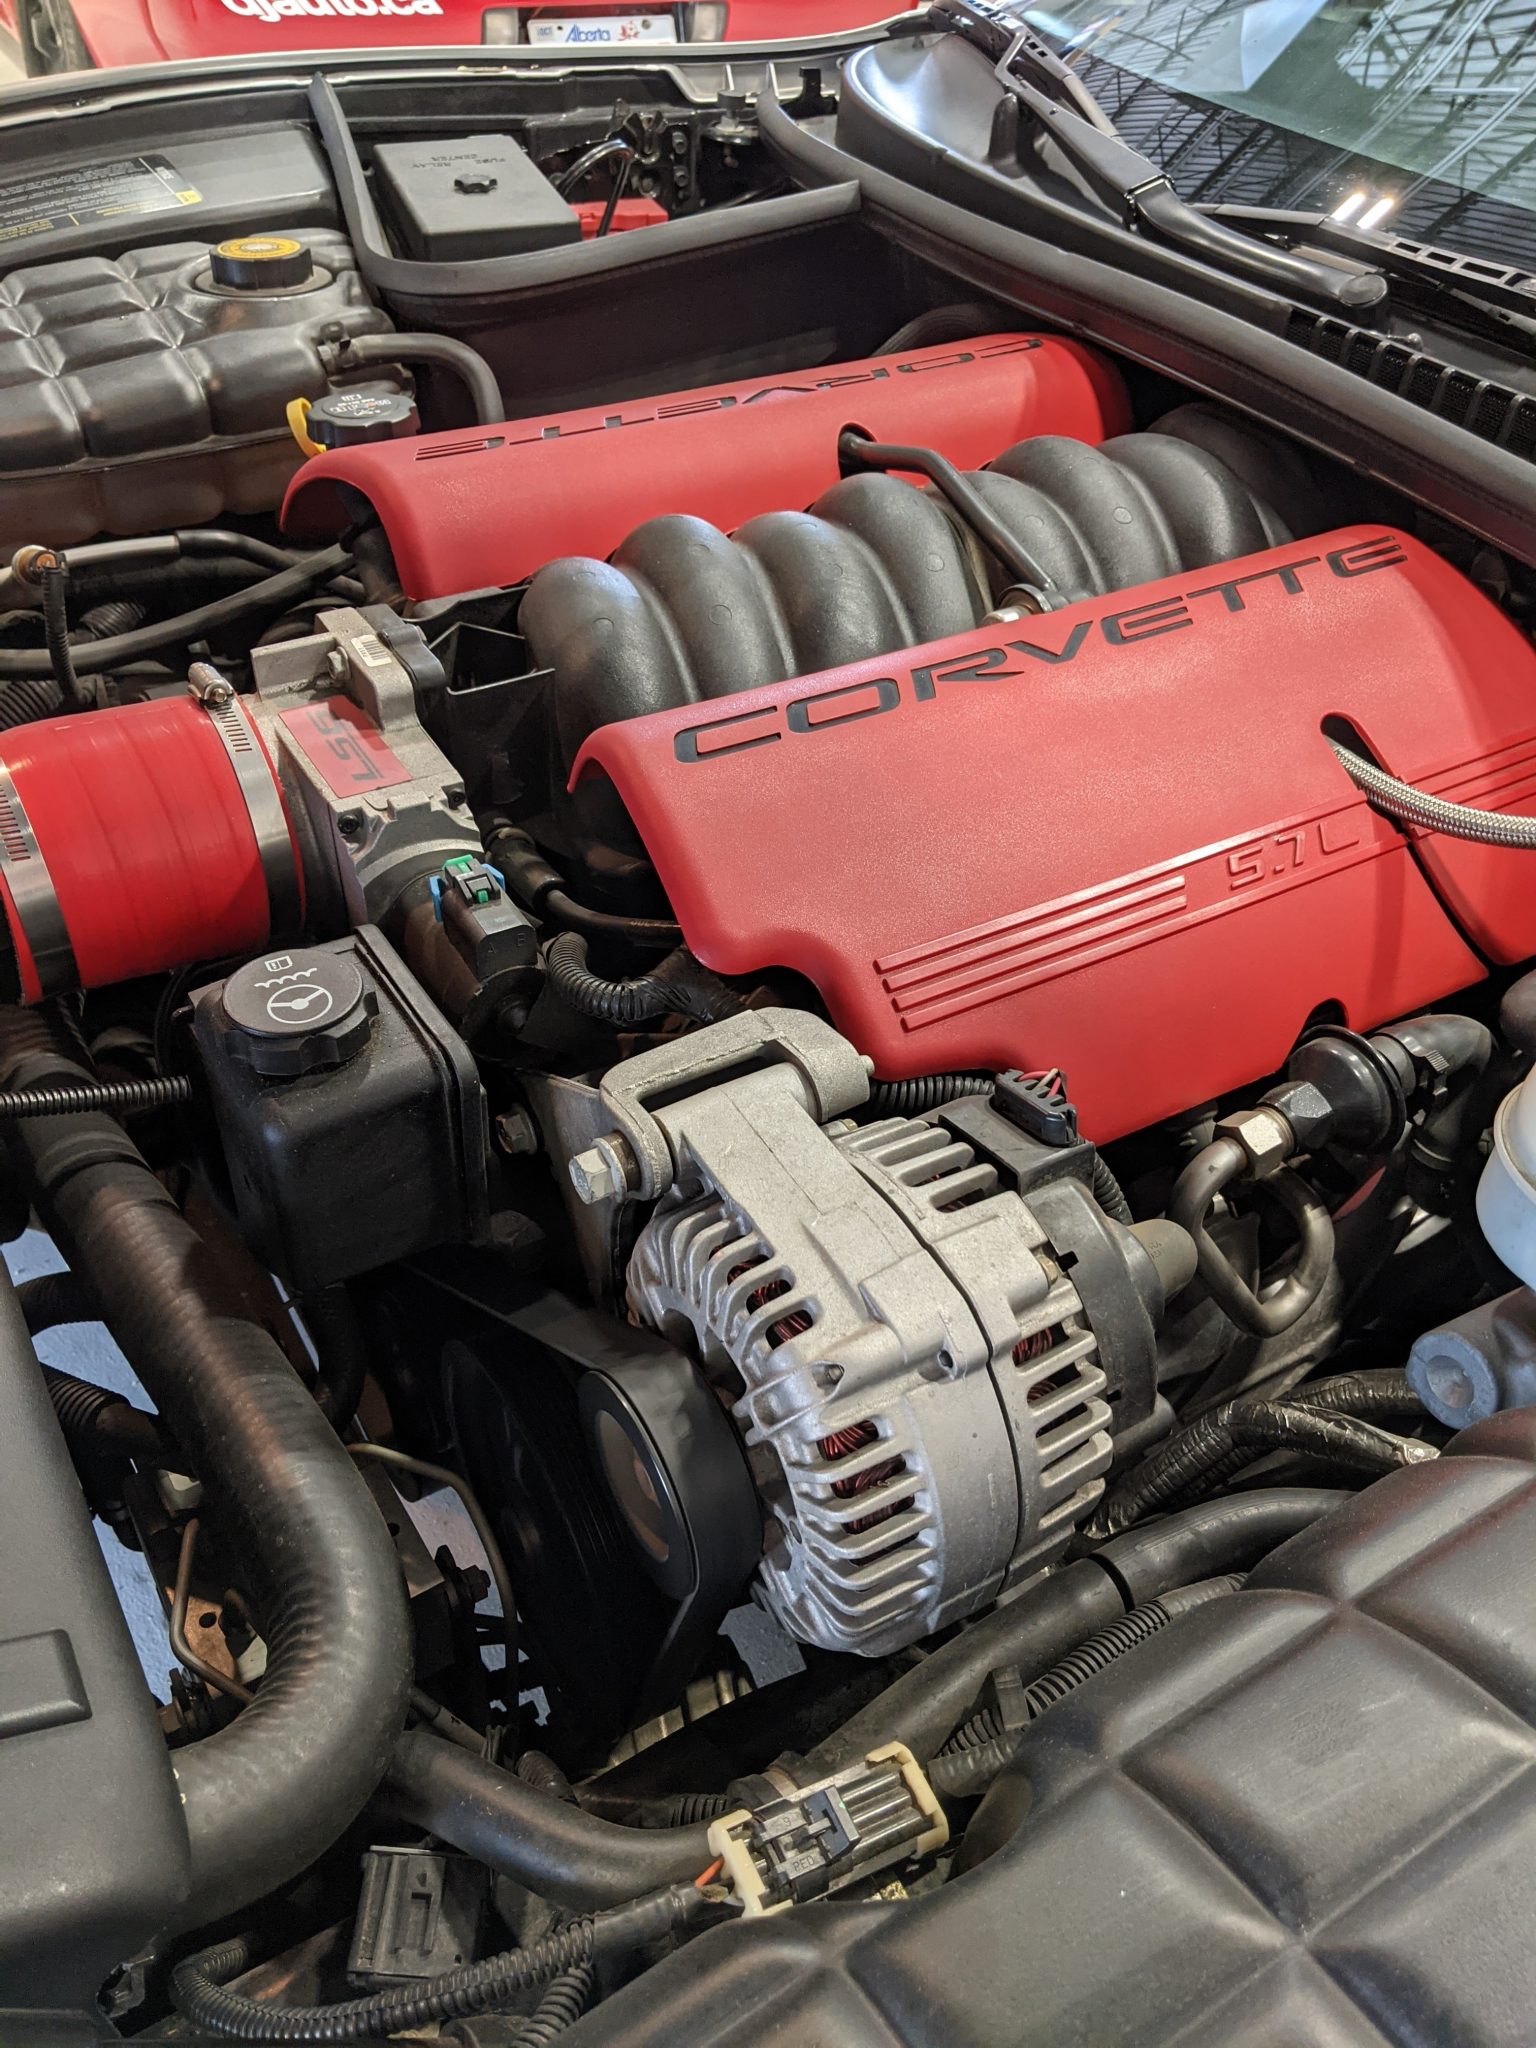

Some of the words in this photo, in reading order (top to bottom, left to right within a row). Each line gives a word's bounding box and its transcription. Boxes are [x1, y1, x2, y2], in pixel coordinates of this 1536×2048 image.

[565, 24, 610, 43] Alberta
[414, 338, 1044, 461] CORVETTE
[673, 536, 1408, 764] CORVETTE
[1226, 822, 1361, 891] 5.7L
[792, 1855, 815, 1873] PED
